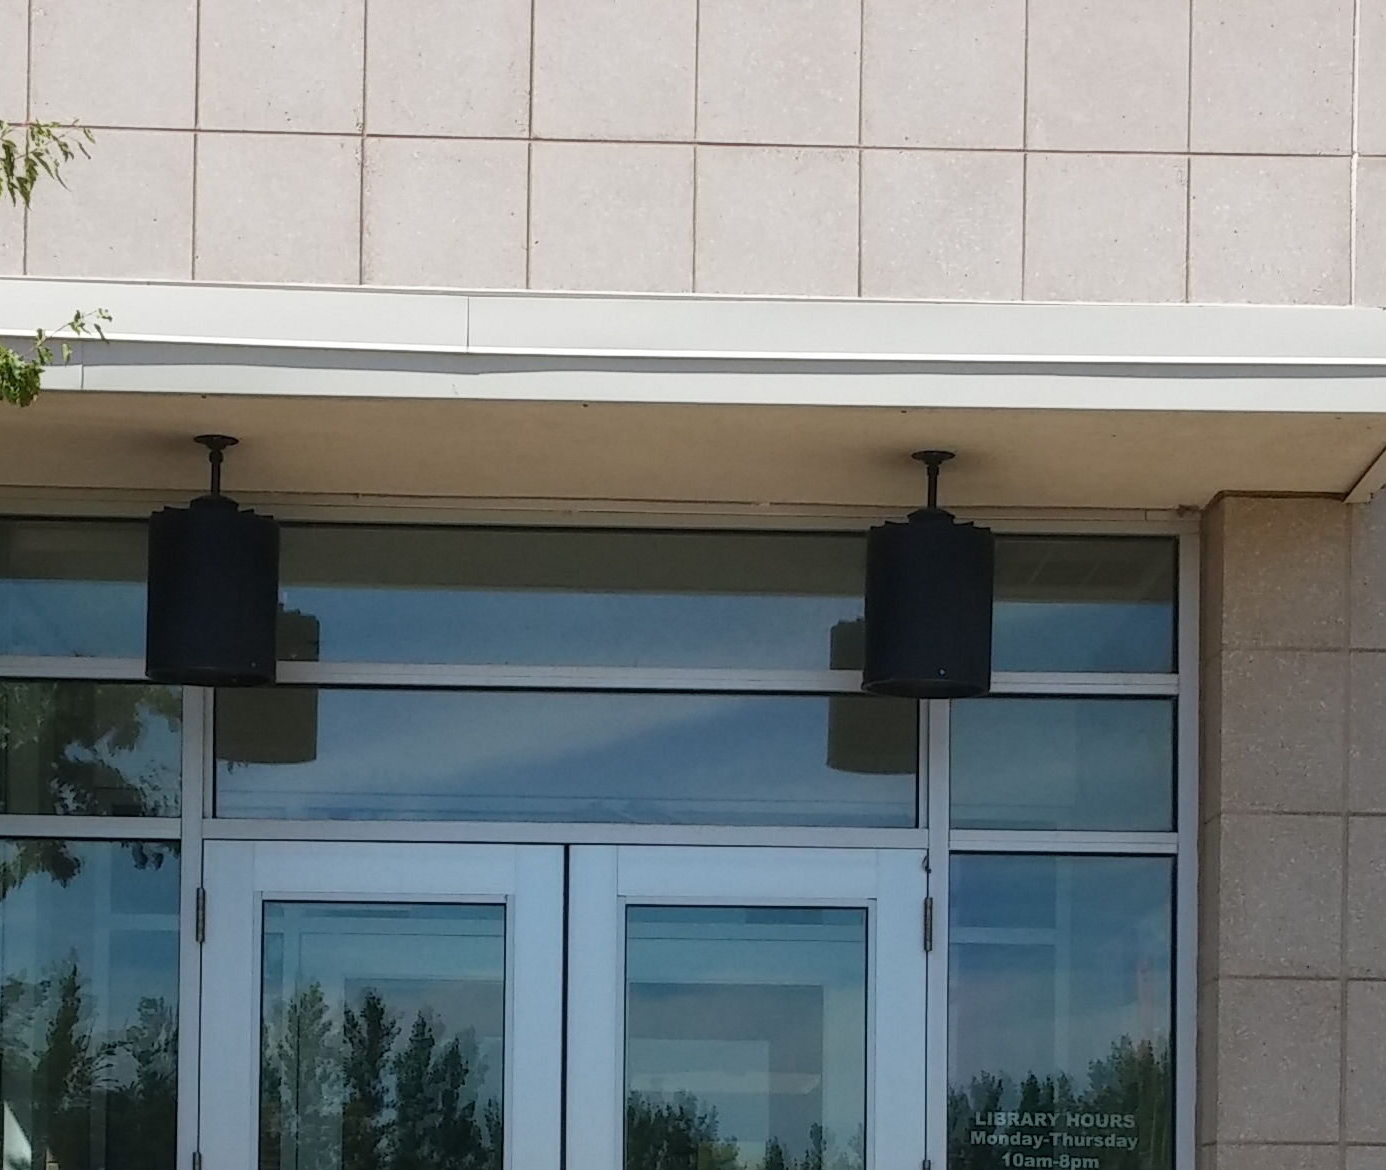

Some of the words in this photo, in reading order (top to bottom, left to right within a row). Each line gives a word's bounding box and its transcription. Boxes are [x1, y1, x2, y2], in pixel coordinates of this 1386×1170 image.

[975, 1111, 1060, 1127] LIBRARY
[1066, 1113, 1136, 1129] HOURS
[970, 1130, 1139, 1151] Monday-Thursday
[1001, 1152, 1100, 1170] 10am-8pm
